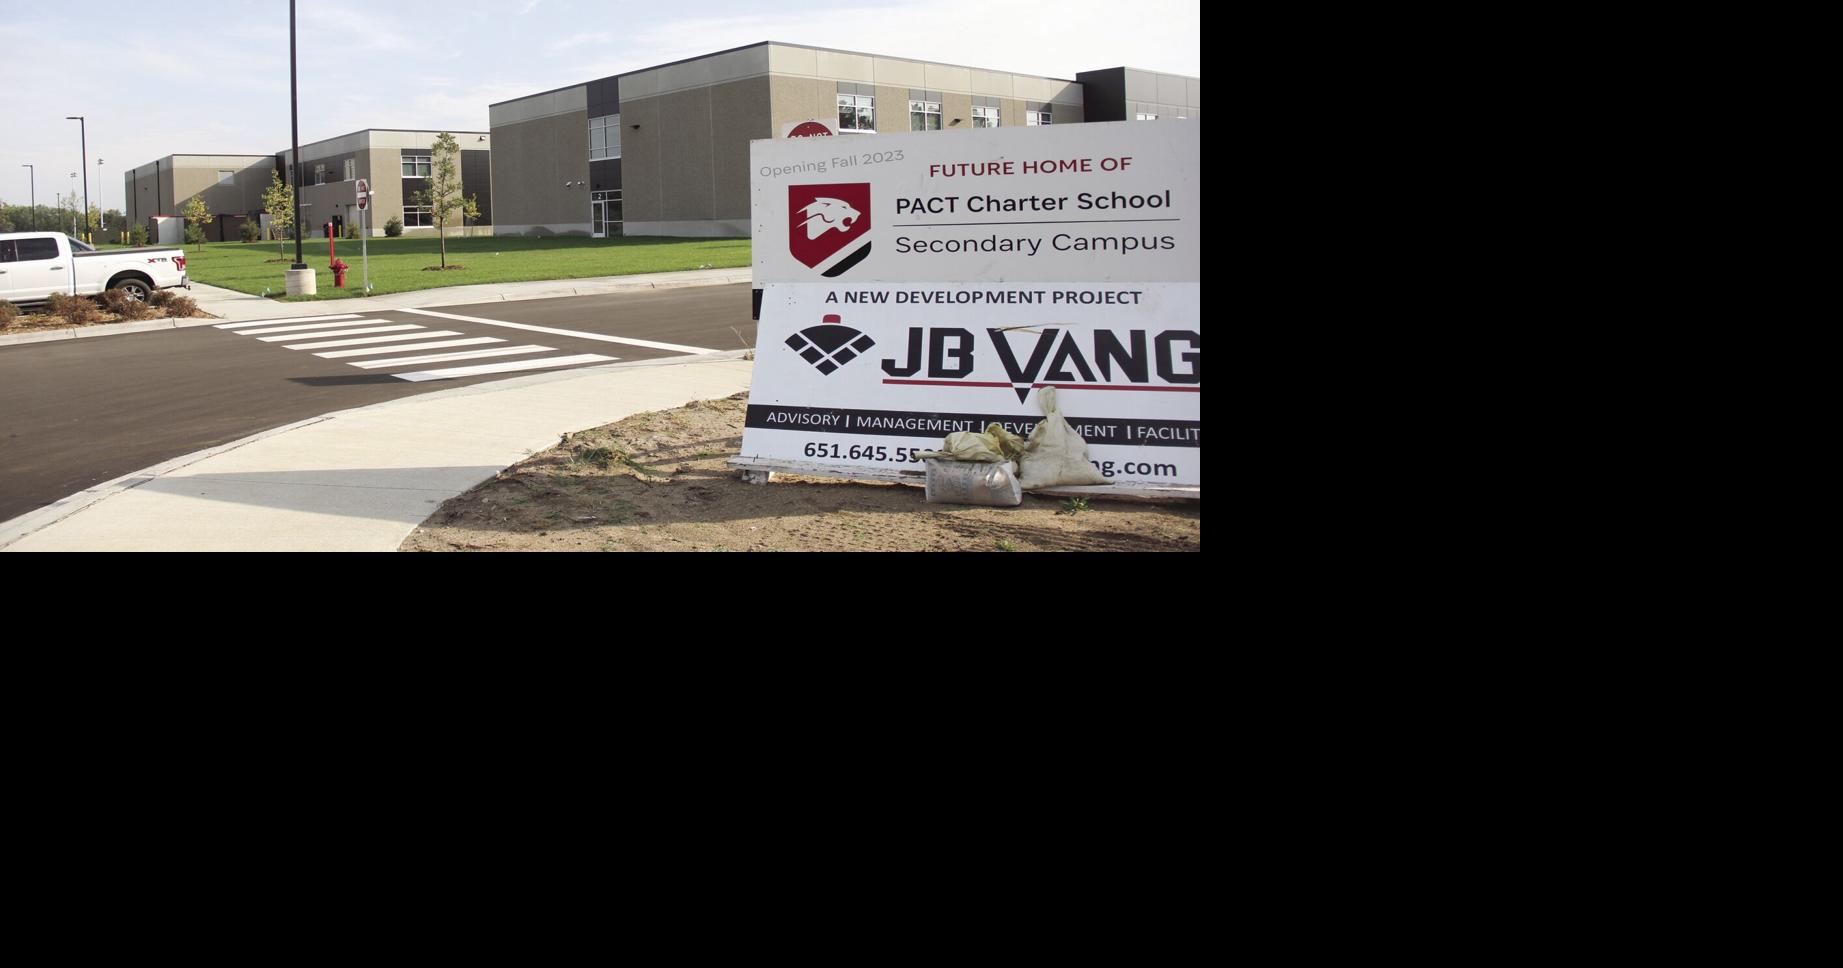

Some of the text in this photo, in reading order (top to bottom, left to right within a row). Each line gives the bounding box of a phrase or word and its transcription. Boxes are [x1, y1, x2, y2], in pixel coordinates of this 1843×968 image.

[760, 149, 905, 178] Opening Fall 2023
[929, 157, 1133, 178] FUTURE HOME OF
[896, 190, 1171, 215] PACT Charter School
[895, 233, 1176, 257] Secondary Campus
[825, 290, 1143, 305] A NEW DEVELOPMENT PROJECT
[881, 326, 1200, 405] JB VANG
[766, 411, 841, 427] ADVISORY
[856, 415, 974, 433] MANAGEMENT
